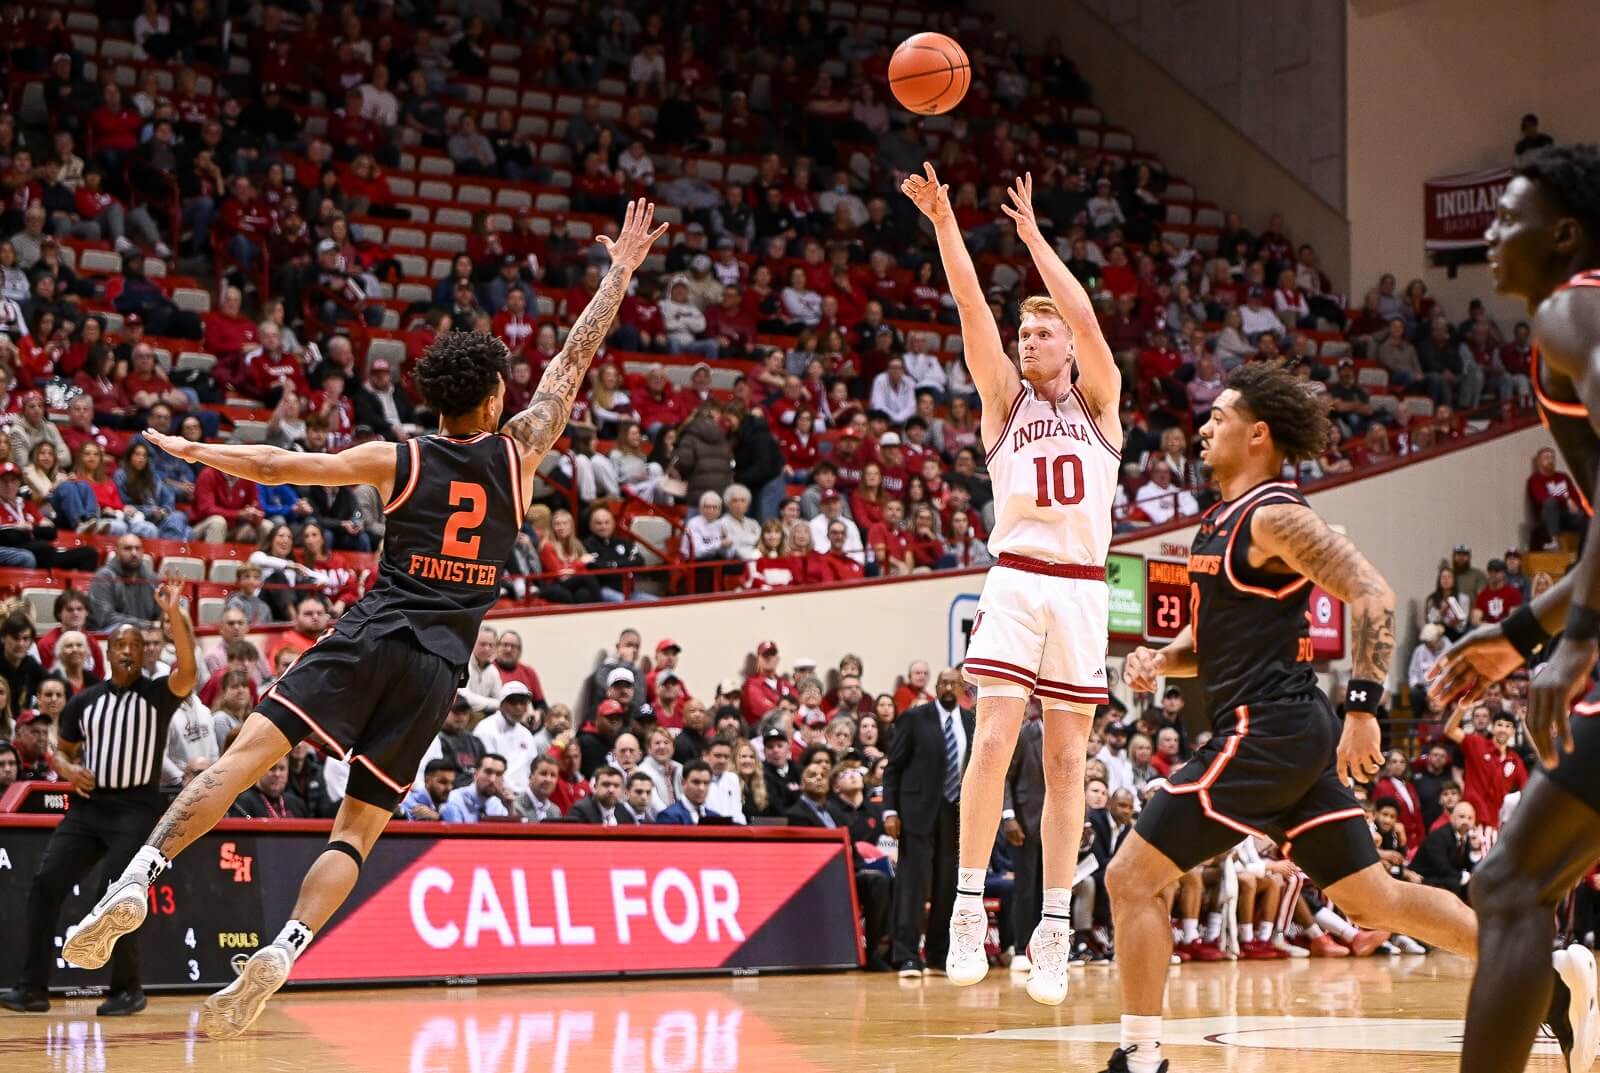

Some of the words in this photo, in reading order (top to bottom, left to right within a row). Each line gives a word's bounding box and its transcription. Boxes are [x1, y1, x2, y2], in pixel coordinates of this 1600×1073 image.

[1435, 184, 1506, 219] INDIAN
[1013, 419, 1092, 453] INDIANA
[1033, 454, 1085, 507] 10
[441, 480, 487, 560] 2
[408, 554, 497, 585] FINISTER
[1157, 595, 1181, 629] 23
[408, 867, 596, 949] CALL
[610, 867, 746, 944] FOR
[184, 927, 197, 949] 4
[218, 932, 260, 948] FOULS
[187, 959, 201, 981] 3
